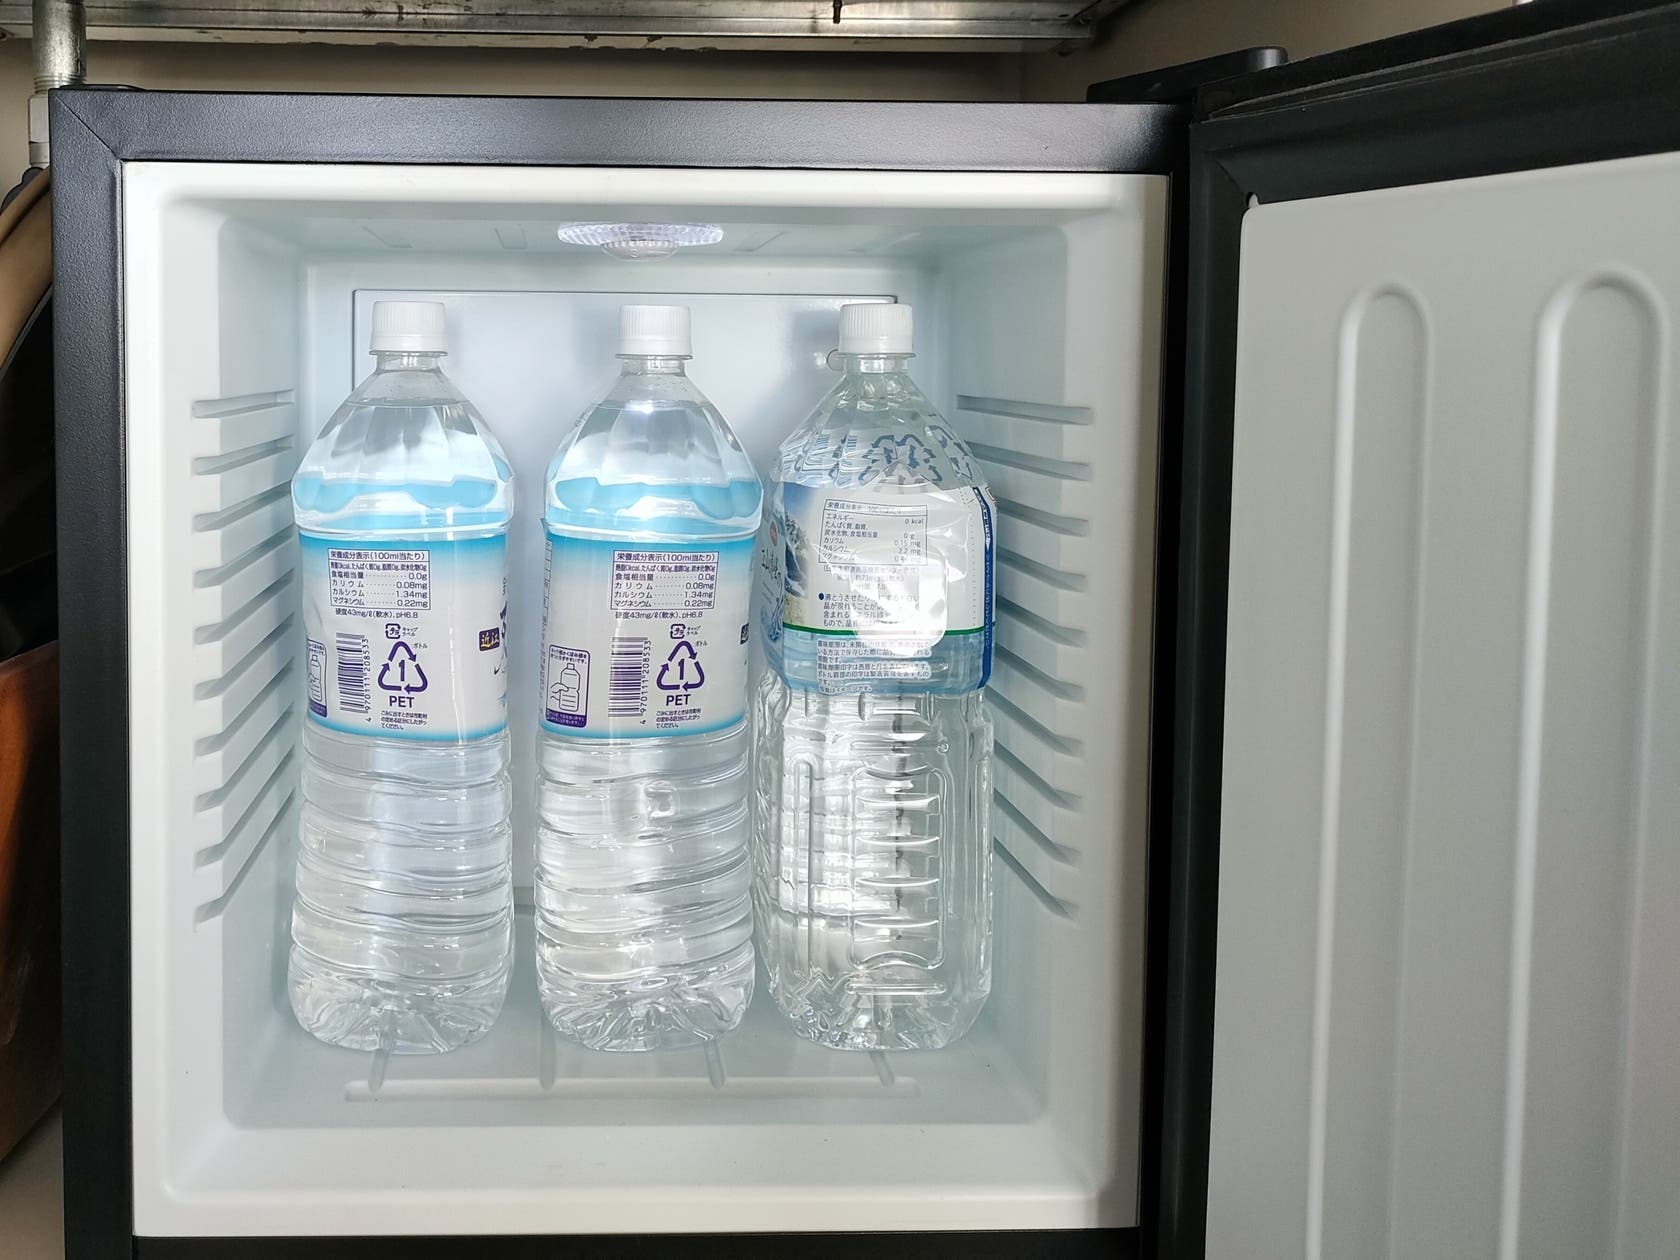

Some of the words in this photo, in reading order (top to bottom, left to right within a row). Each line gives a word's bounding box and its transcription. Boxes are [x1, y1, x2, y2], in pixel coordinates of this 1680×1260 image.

[396, 581, 427, 590] 0.08mg
[685, 582, 714, 590] 0.08mg
[332, 588, 364, 597] カルシウム
[396, 590, 427, 599] 1.34mg
[684, 591, 713, 599] 1.34mg
[333, 597, 365, 606] マグネシウム
[397, 600, 428, 608] 0.22mg
[481, 632, 500, 648] 近江
[362, 638, 371, 672] 208533
[642, 640, 652, 674] 208533
[389, 696, 415, 708] PET
[640, 679, 648, 713] 970111
[666, 694, 691, 706] PET
